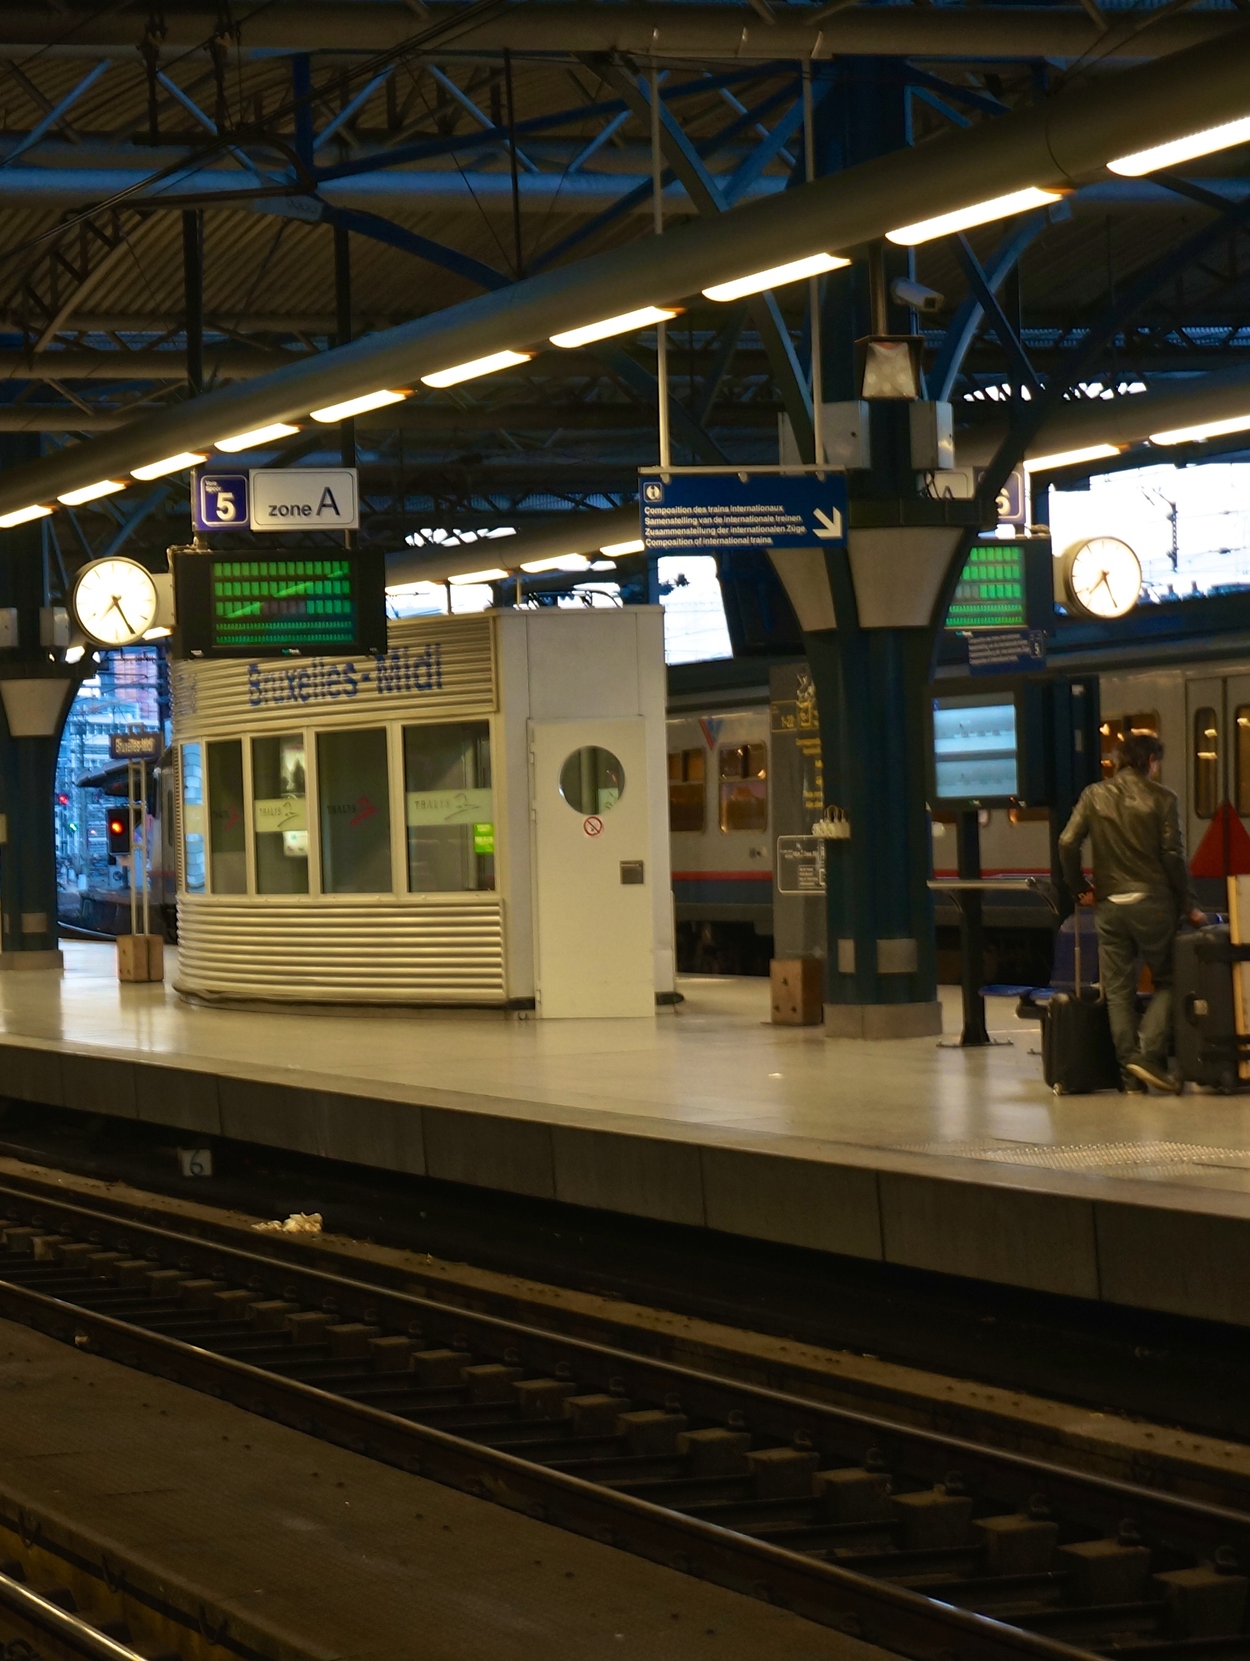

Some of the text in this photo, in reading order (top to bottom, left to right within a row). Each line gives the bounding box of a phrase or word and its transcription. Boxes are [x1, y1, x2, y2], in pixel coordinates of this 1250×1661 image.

[216, 492, 236, 522] 5
[268, 486, 341, 517] zone A
[644, 504, 785, 516] Composition des trains internationaux
[644, 516, 699, 526] Samenstelling
[724, 515, 775, 523] internationale
[645, 526, 717, 537] Zusammenstellung
[717, 526, 729, 534] der
[730, 525, 786, 534] internationalen
[645, 536, 773, 548] Composition of international trains
